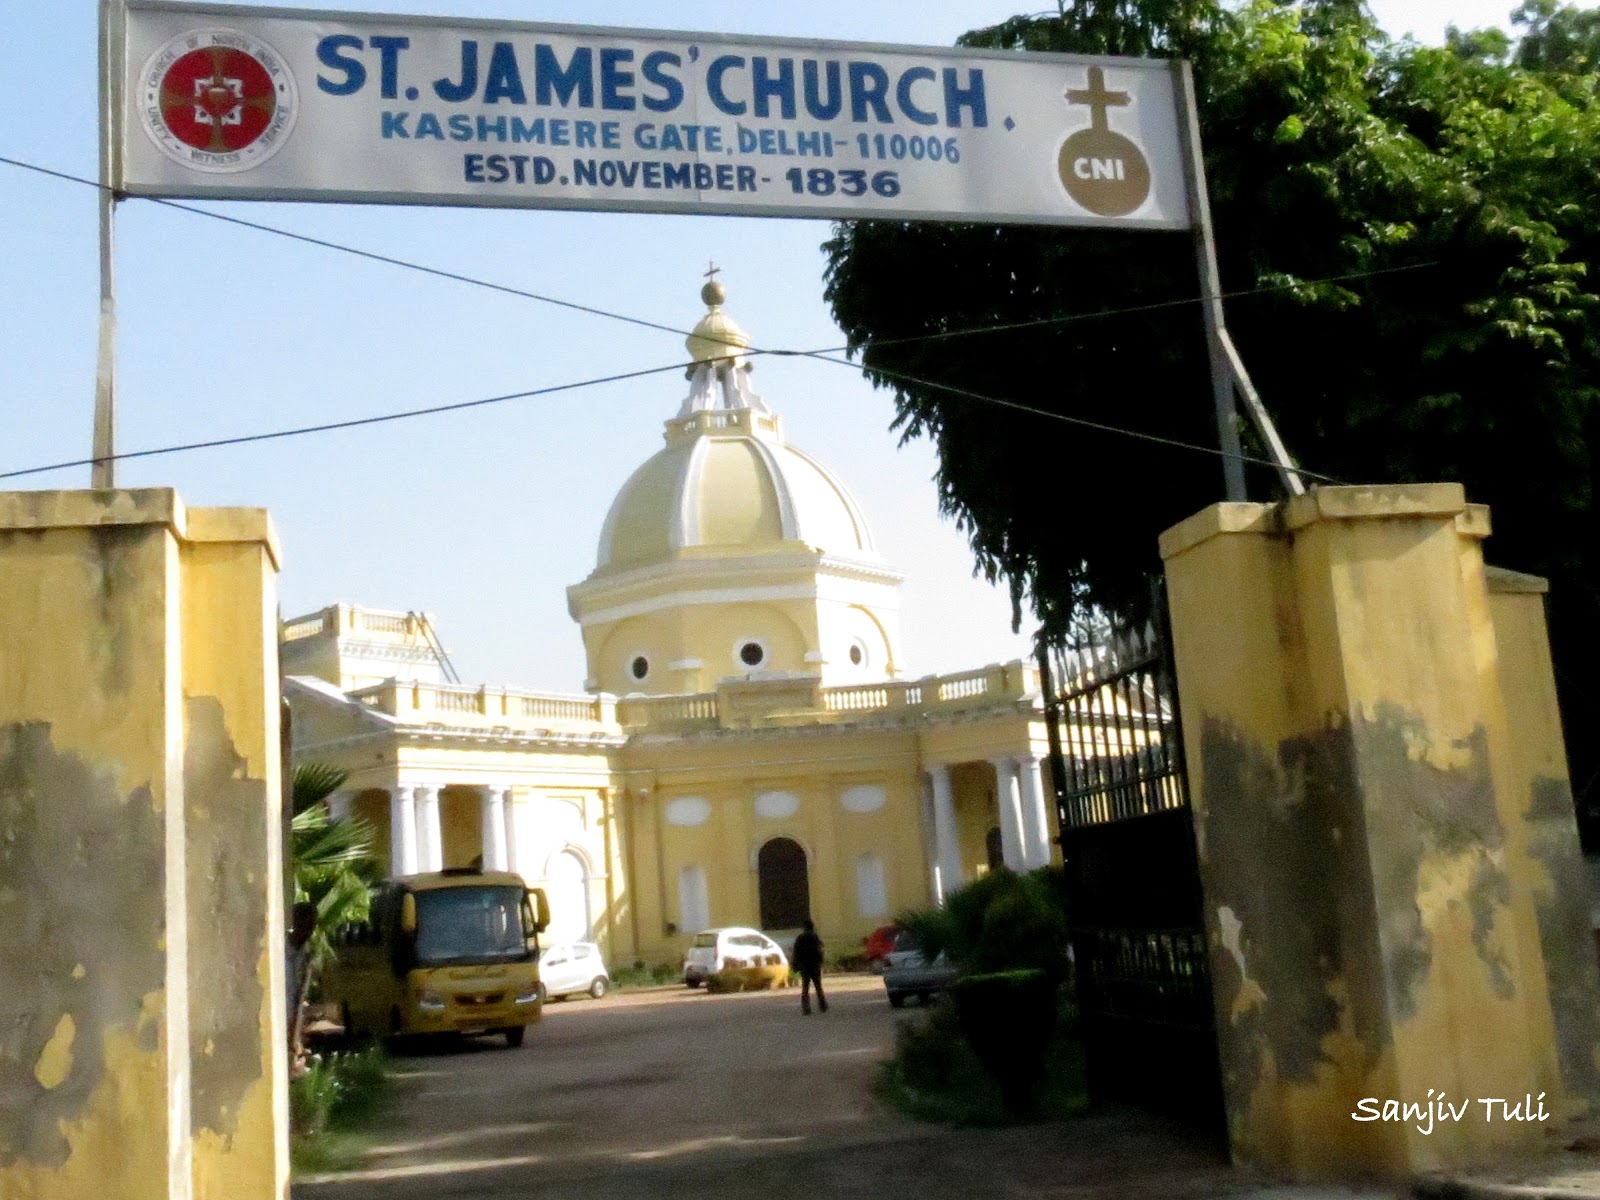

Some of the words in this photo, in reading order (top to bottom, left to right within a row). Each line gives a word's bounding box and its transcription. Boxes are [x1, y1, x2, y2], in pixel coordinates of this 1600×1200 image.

[315, 34, 419, 101] ST.
[381, 111, 622, 150] KASHMERE
[856, 132, 961, 164] 110006
[786, 167, 901, 198] 1836
[1073, 157, 1125, 181] CNI
